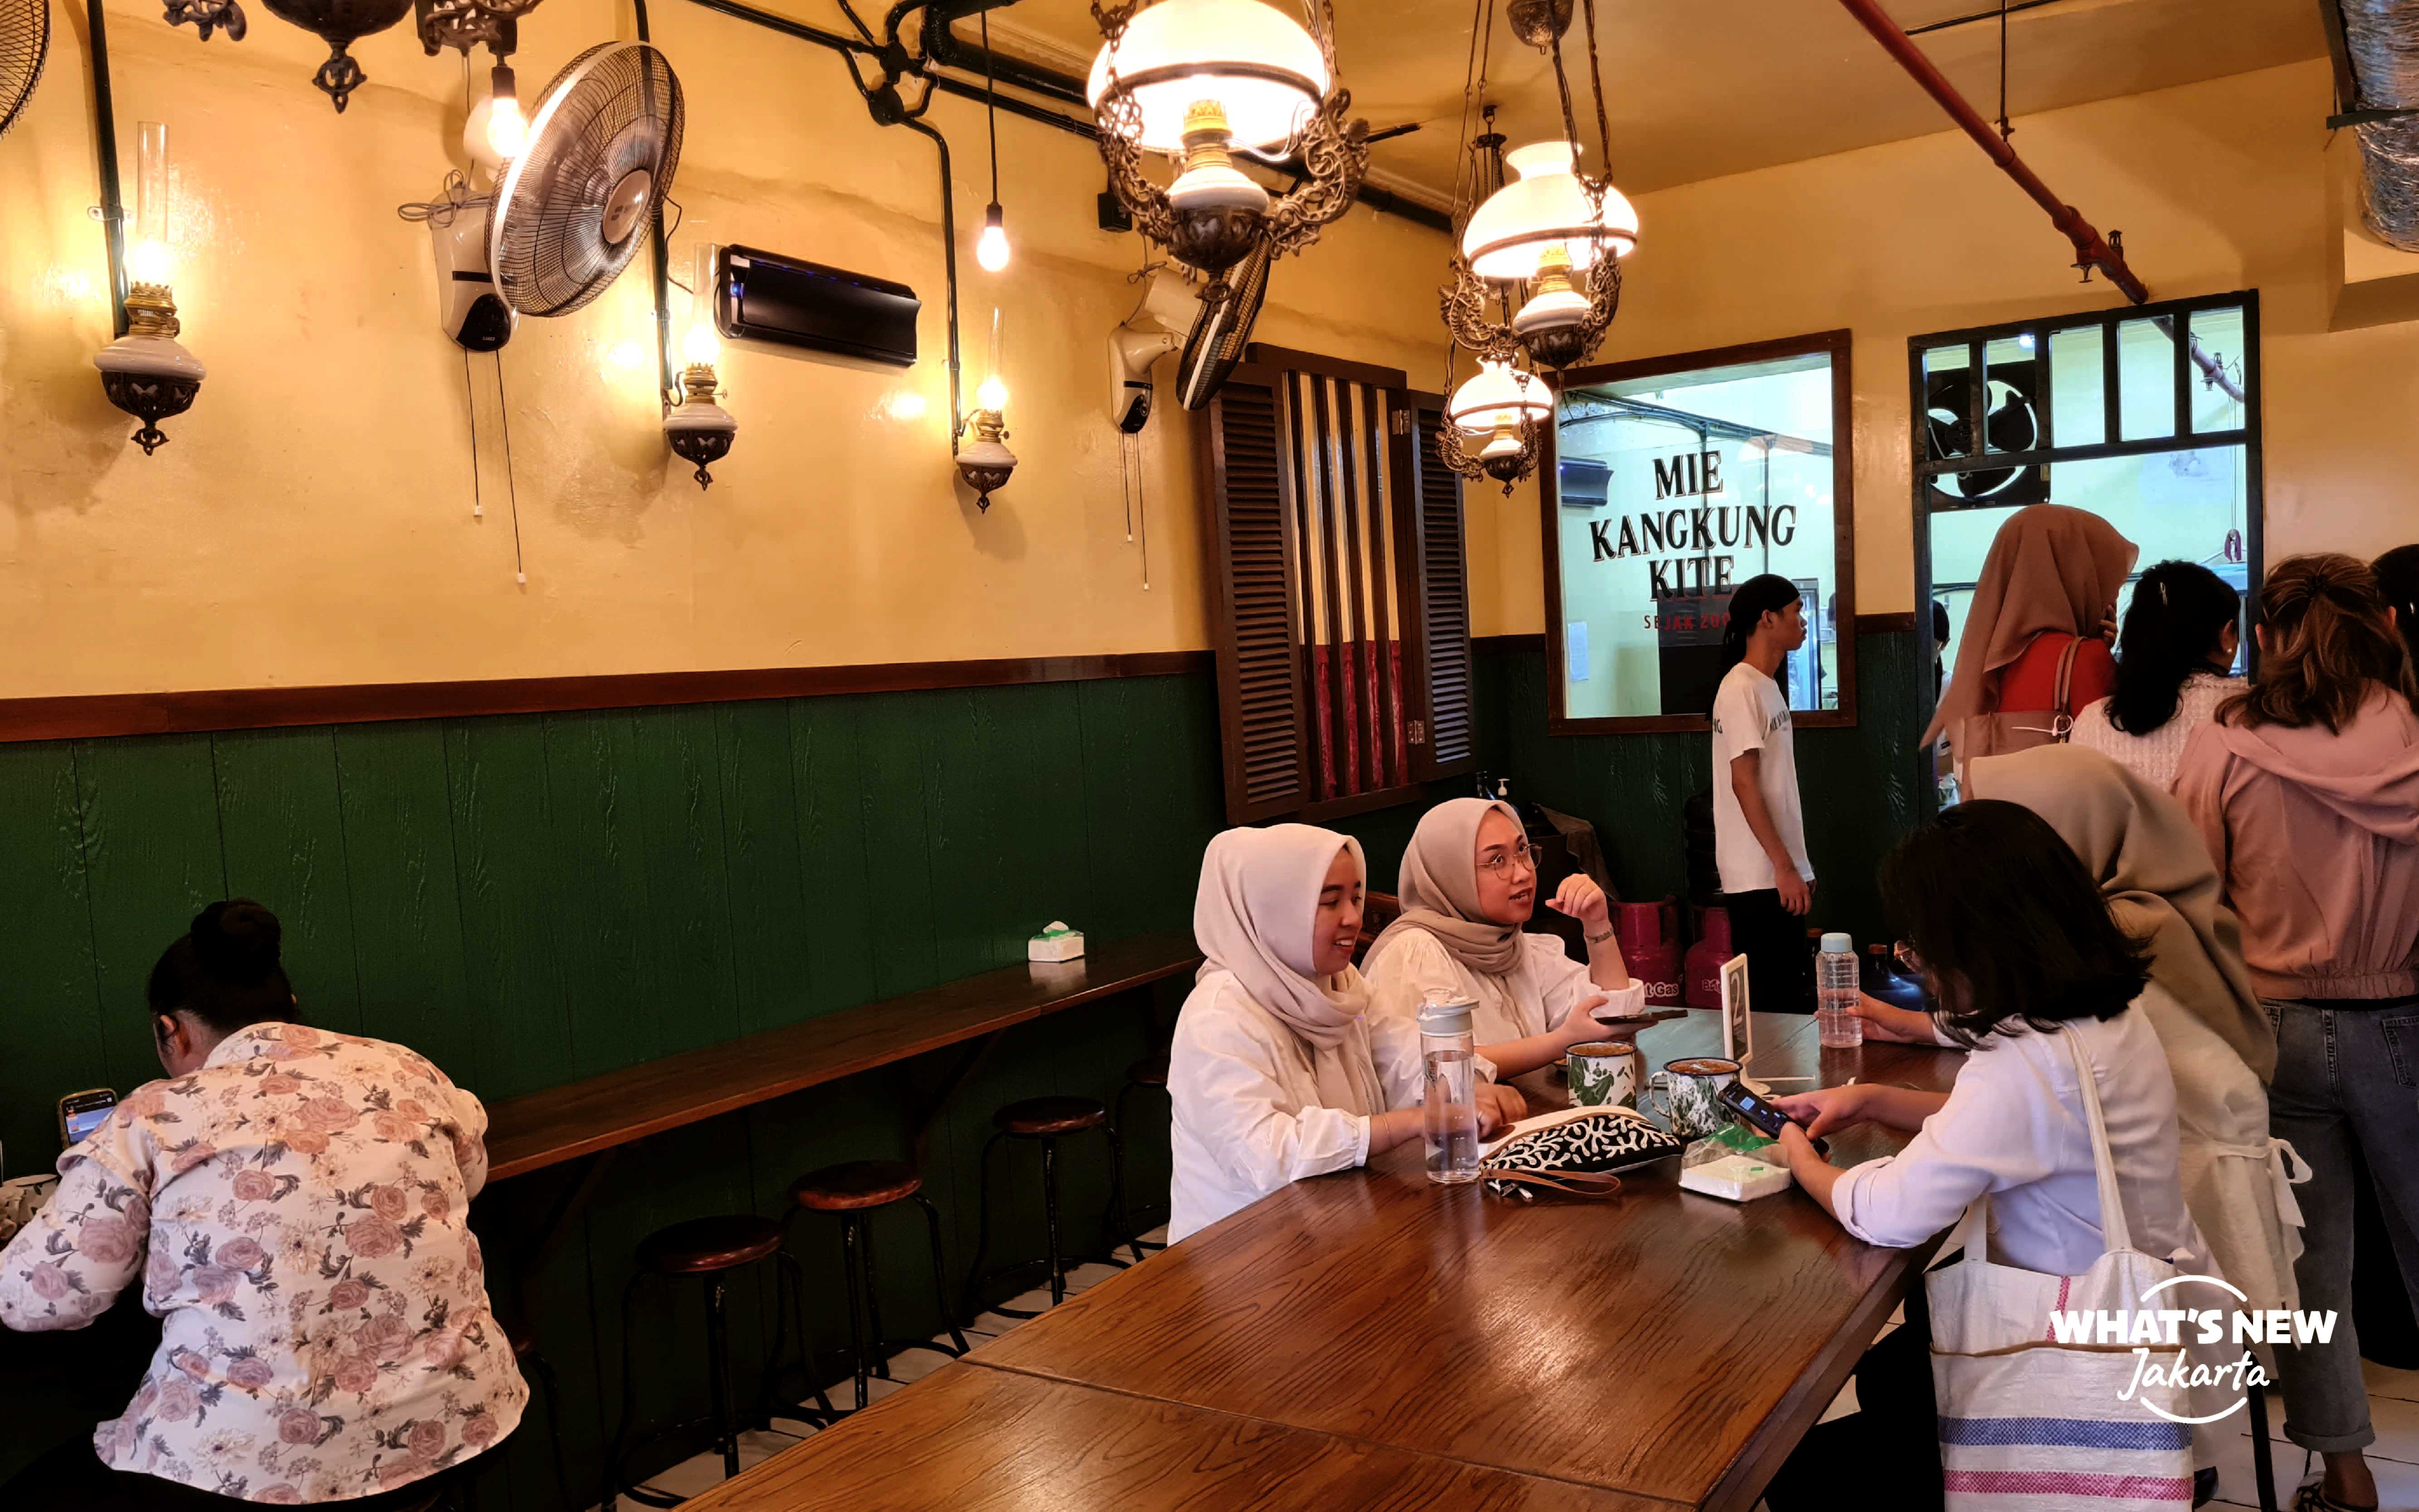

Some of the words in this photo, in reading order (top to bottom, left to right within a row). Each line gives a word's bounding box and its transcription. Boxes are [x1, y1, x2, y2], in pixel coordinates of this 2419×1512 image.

[1653, 450, 1724, 501] MIE
[1589, 505, 1796, 562] KANGKUNG
[1649, 555, 1734, 602] KITE
[1644, 615, 1694, 630] SEJAK
[1701, 612, 1731, 629] 200
[1654, 983, 1678, 996] Gas
[1731, 971, 1743, 1026] 2
